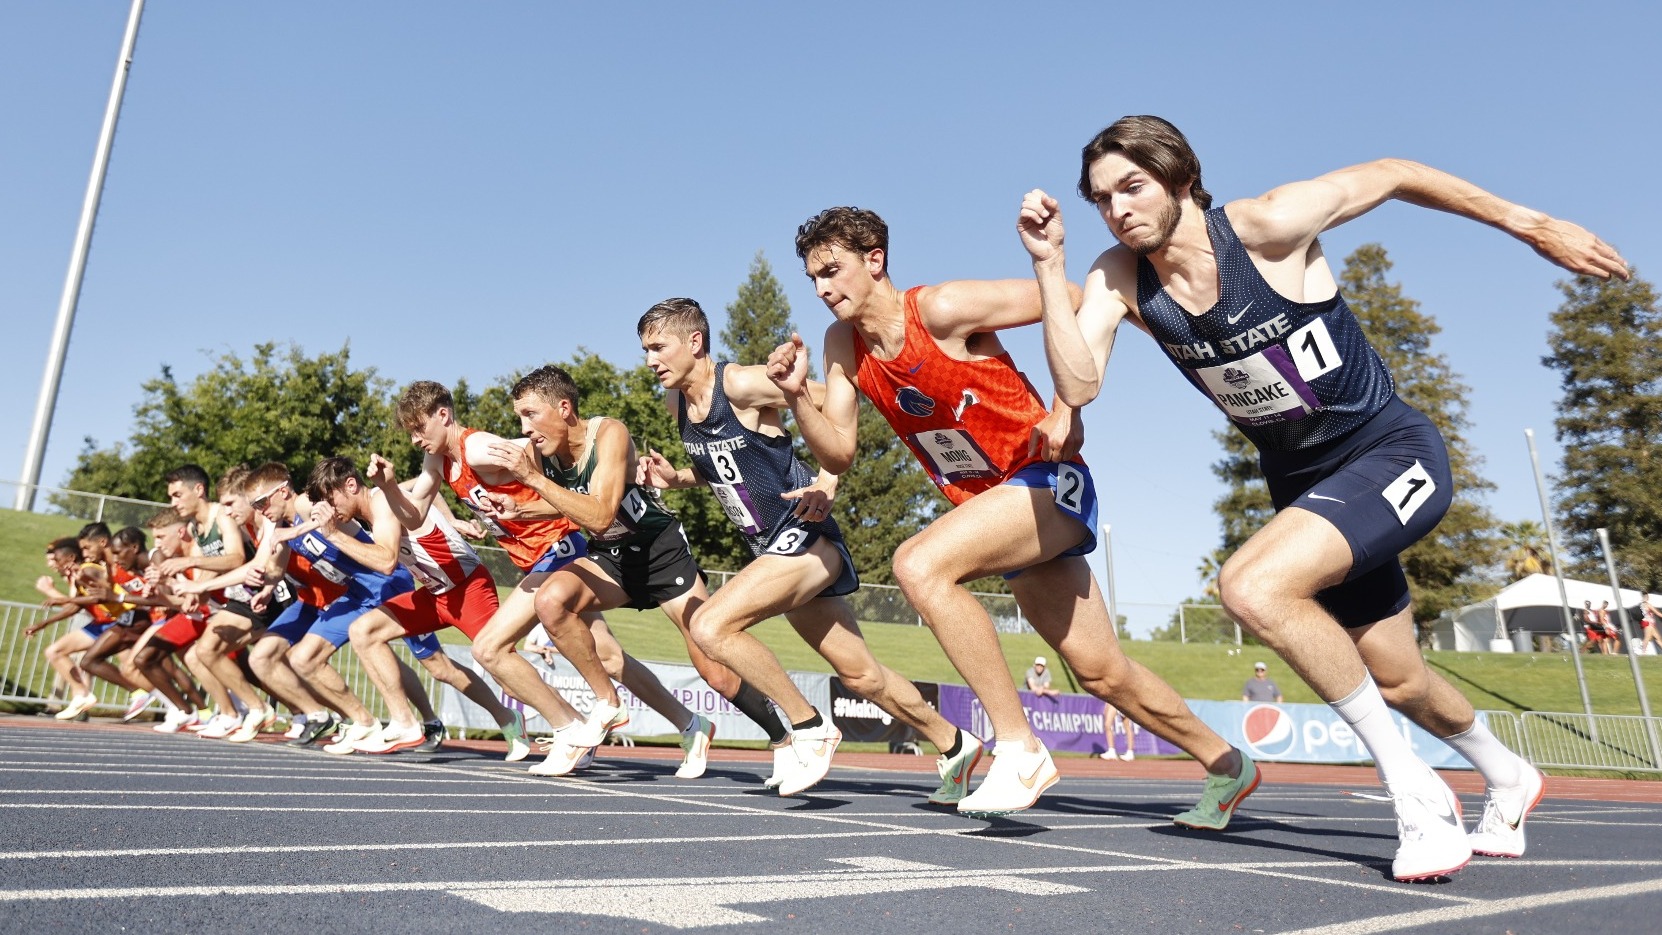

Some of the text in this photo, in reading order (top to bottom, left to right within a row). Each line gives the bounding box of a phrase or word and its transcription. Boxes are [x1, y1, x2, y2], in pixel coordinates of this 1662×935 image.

[1220, 312, 1293, 355] STATE
[1301, 330, 1326, 370] 1
[1216, 381, 1290, 408] PANCAKE
[707, 435, 747, 453] STATE
[940, 449, 972, 463] MONG
[717, 454, 736, 482] 3
[1060, 471, 1080, 508] 2
[1398, 477, 1426, 510] 1
[629, 493, 644, 515] 4
[306, 537, 320, 553] 7
[776, 532, 799, 552] 3
[276, 585, 285, 598] 9
[552, 676, 593, 689] MOUN
[562, 690, 595, 714] ES
[1032, 711, 1141, 735] CHAMPIONH
[1303, 717, 1412, 756] pei
